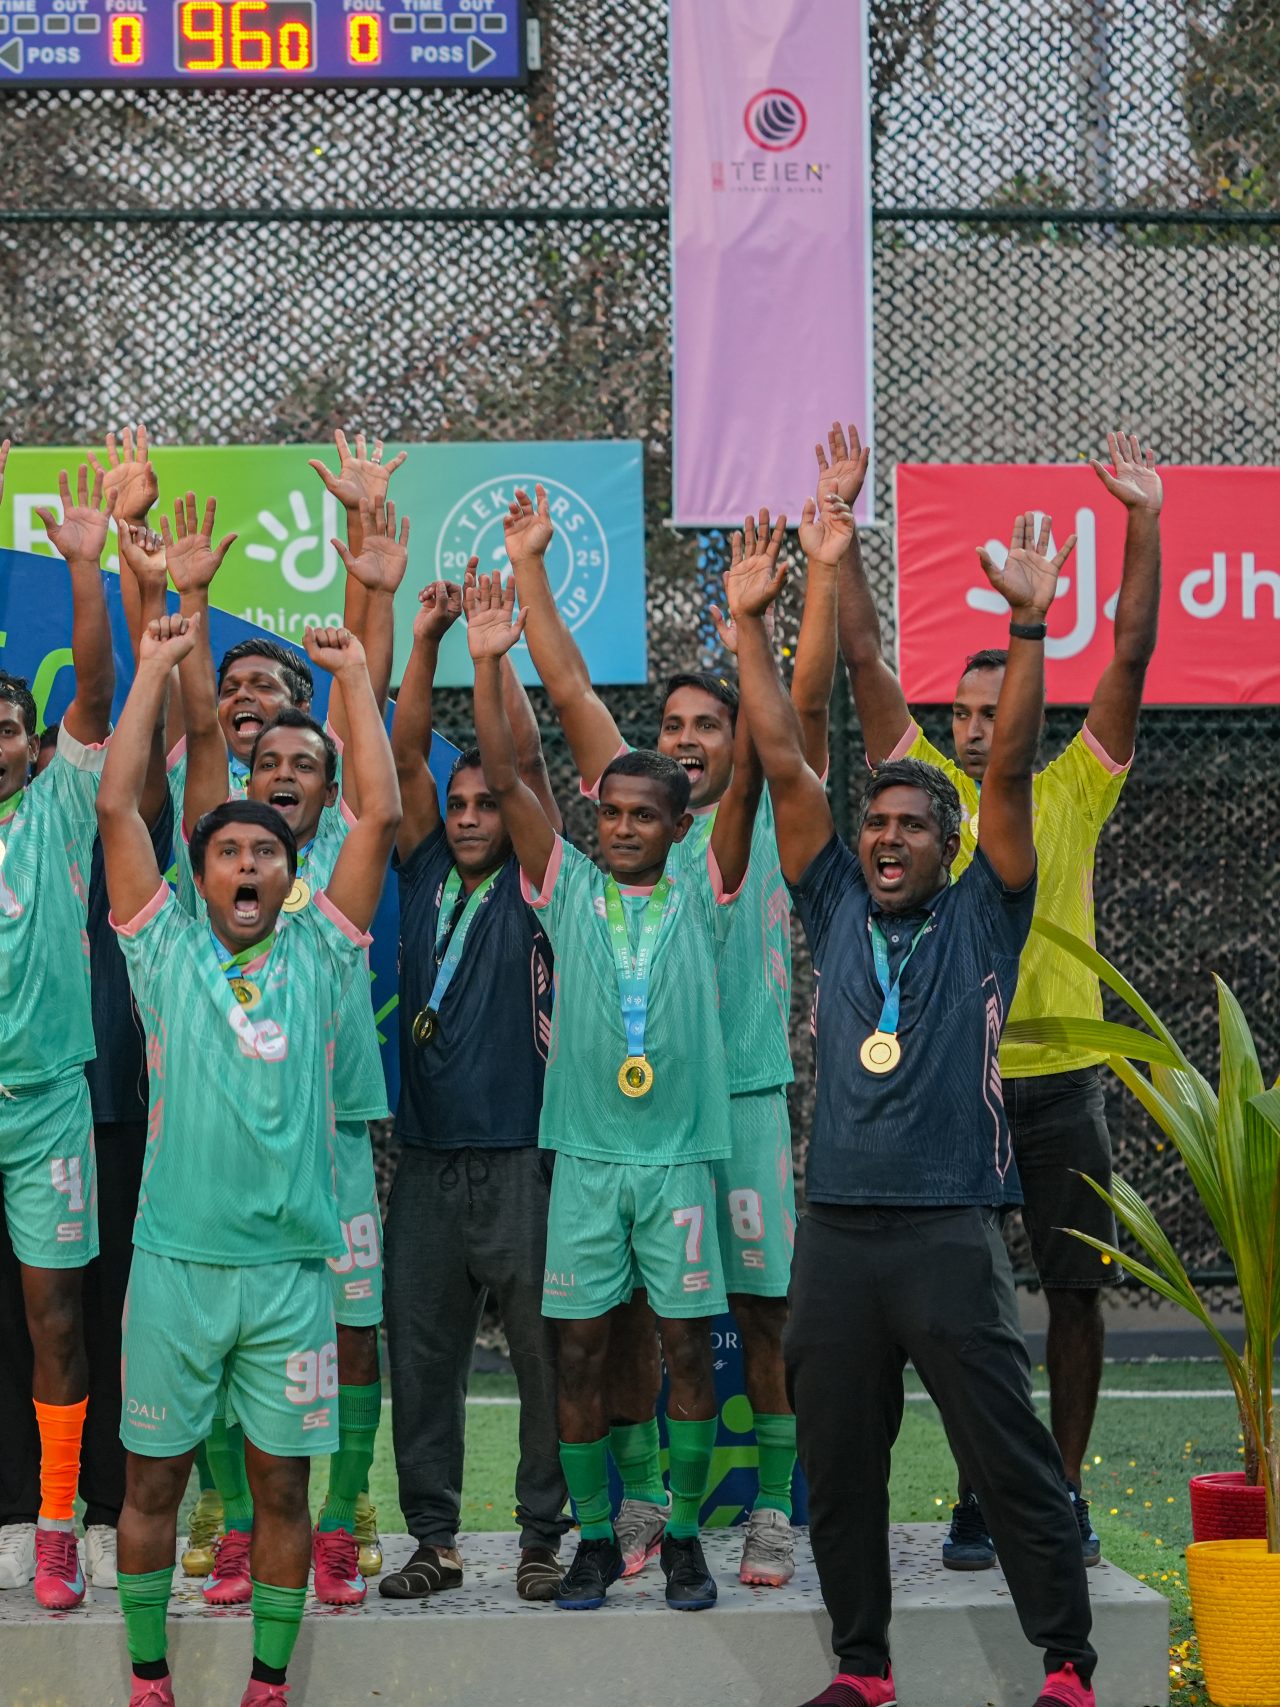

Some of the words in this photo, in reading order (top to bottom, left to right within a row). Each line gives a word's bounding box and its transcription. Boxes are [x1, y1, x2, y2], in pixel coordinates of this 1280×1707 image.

[52, 0, 89, 12] OUT
[106, 0, 148, 12] FOUL
[343, 0, 385, 11] FOUL
[402, 0, 443, 11] TIME
[459, 0, 495, 11] OUT
[111, 16, 142, 64] 0
[349, 15, 379, 63] 0
[27, 47, 81, 64] POSS
[411, 46, 464, 63] POSS
[730, 162, 823, 182] TEIEN
[443, 551, 468, 568] 20
[576, 550, 601, 567] 25
[562, 586, 588, 619] UP
[620, 946, 632, 980] TEKKERS
[637, 947, 648, 981] TEKKERS
[51, 1157, 85, 1212] 4
[728, 1188, 765, 1241] 8
[672, 1205, 706, 1264] 7
[544, 1268, 575, 1287] OALI
[710, 1331, 738, 1350] OR
[285, 1343, 339, 1405] 96
[126, 1398, 167, 1421] OALI
